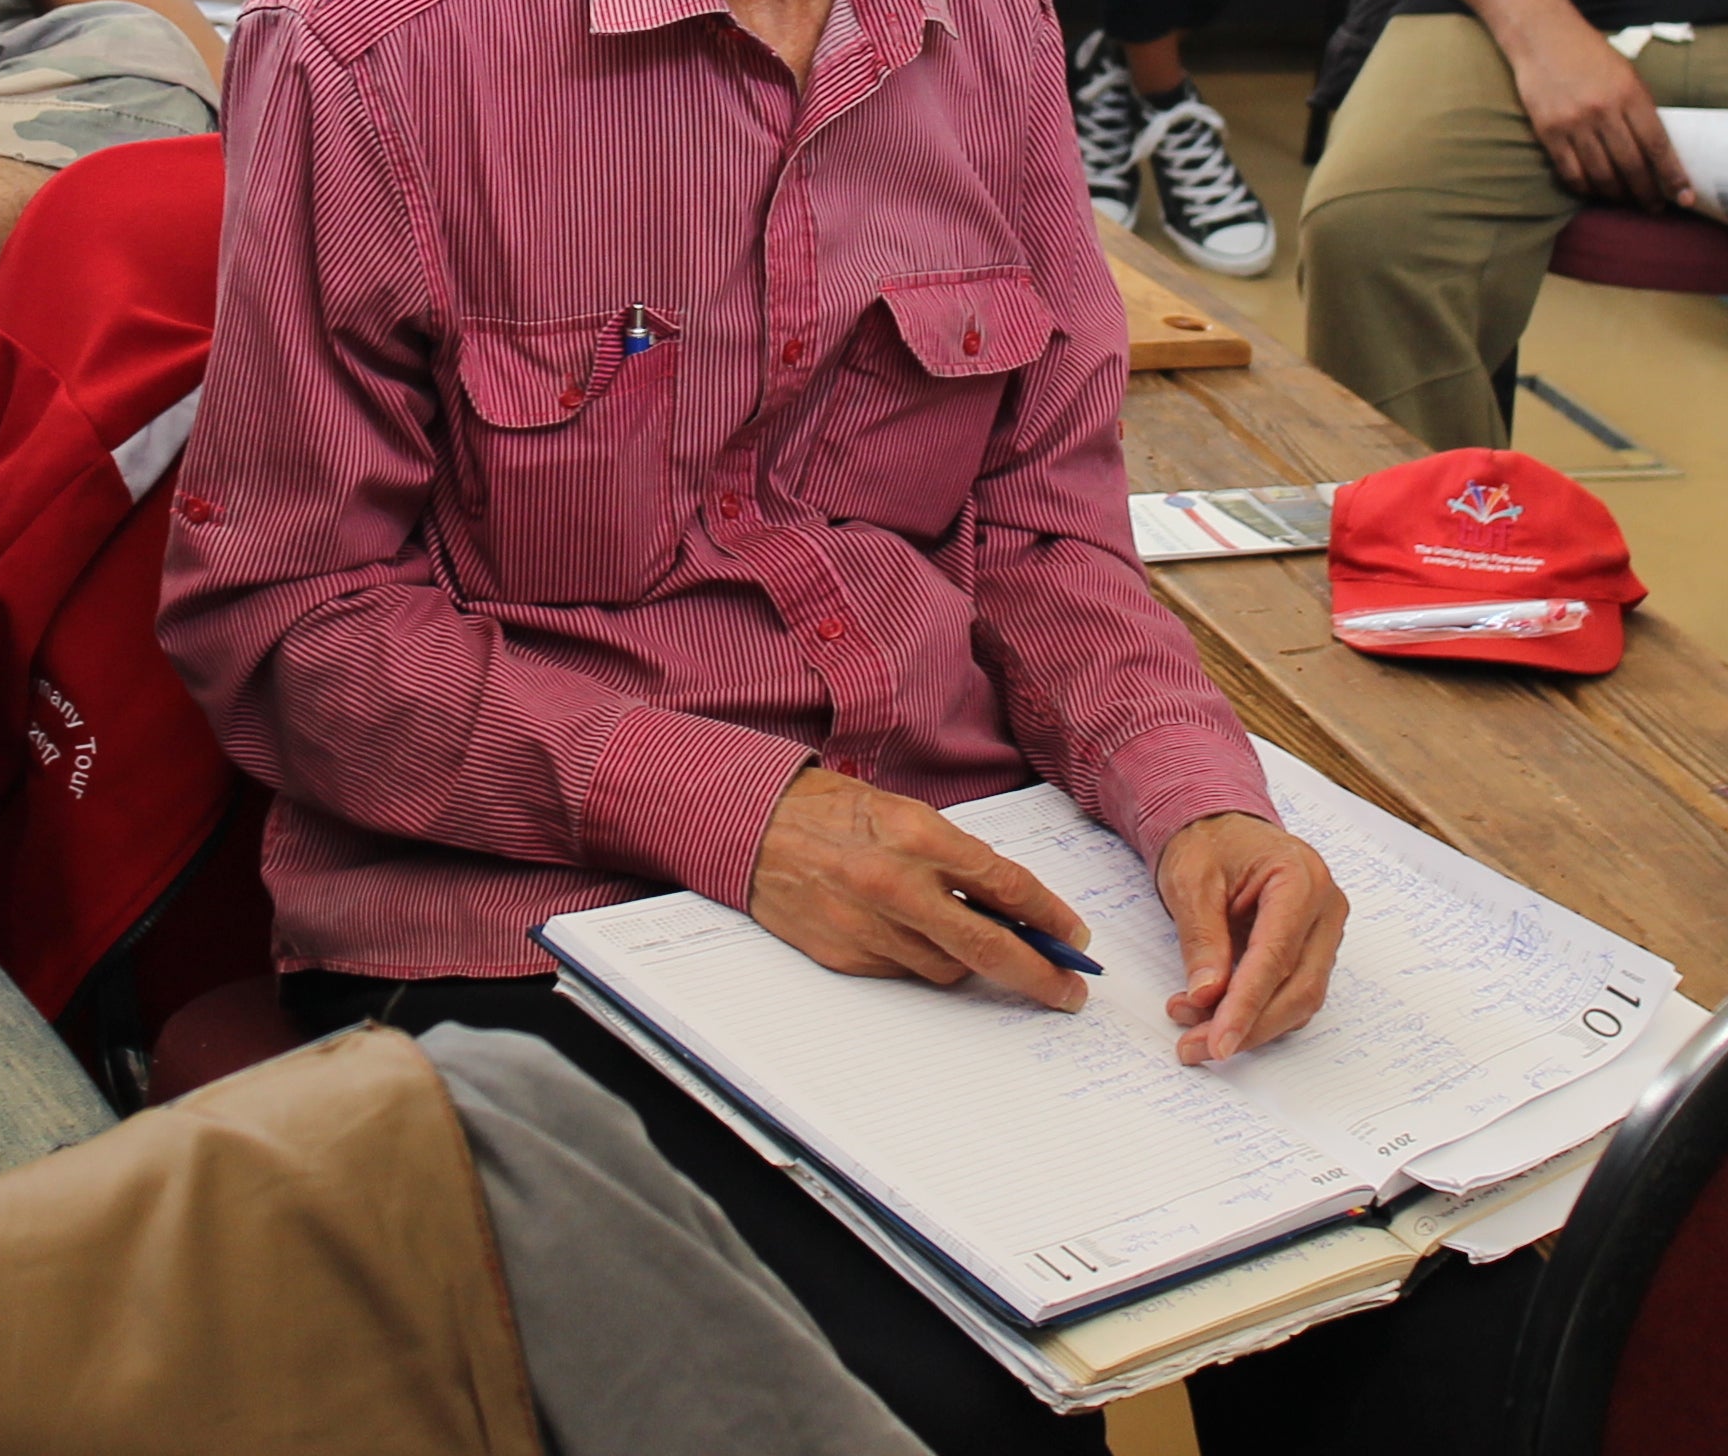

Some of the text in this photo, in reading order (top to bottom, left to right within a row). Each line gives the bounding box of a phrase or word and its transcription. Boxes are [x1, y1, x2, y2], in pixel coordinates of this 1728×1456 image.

[69, 736, 97, 800] Tour
[1581, 982, 1643, 1038] 10
[1377, 1131, 1418, 1158] 2016
[1310, 1165, 1349, 1187] 2016
